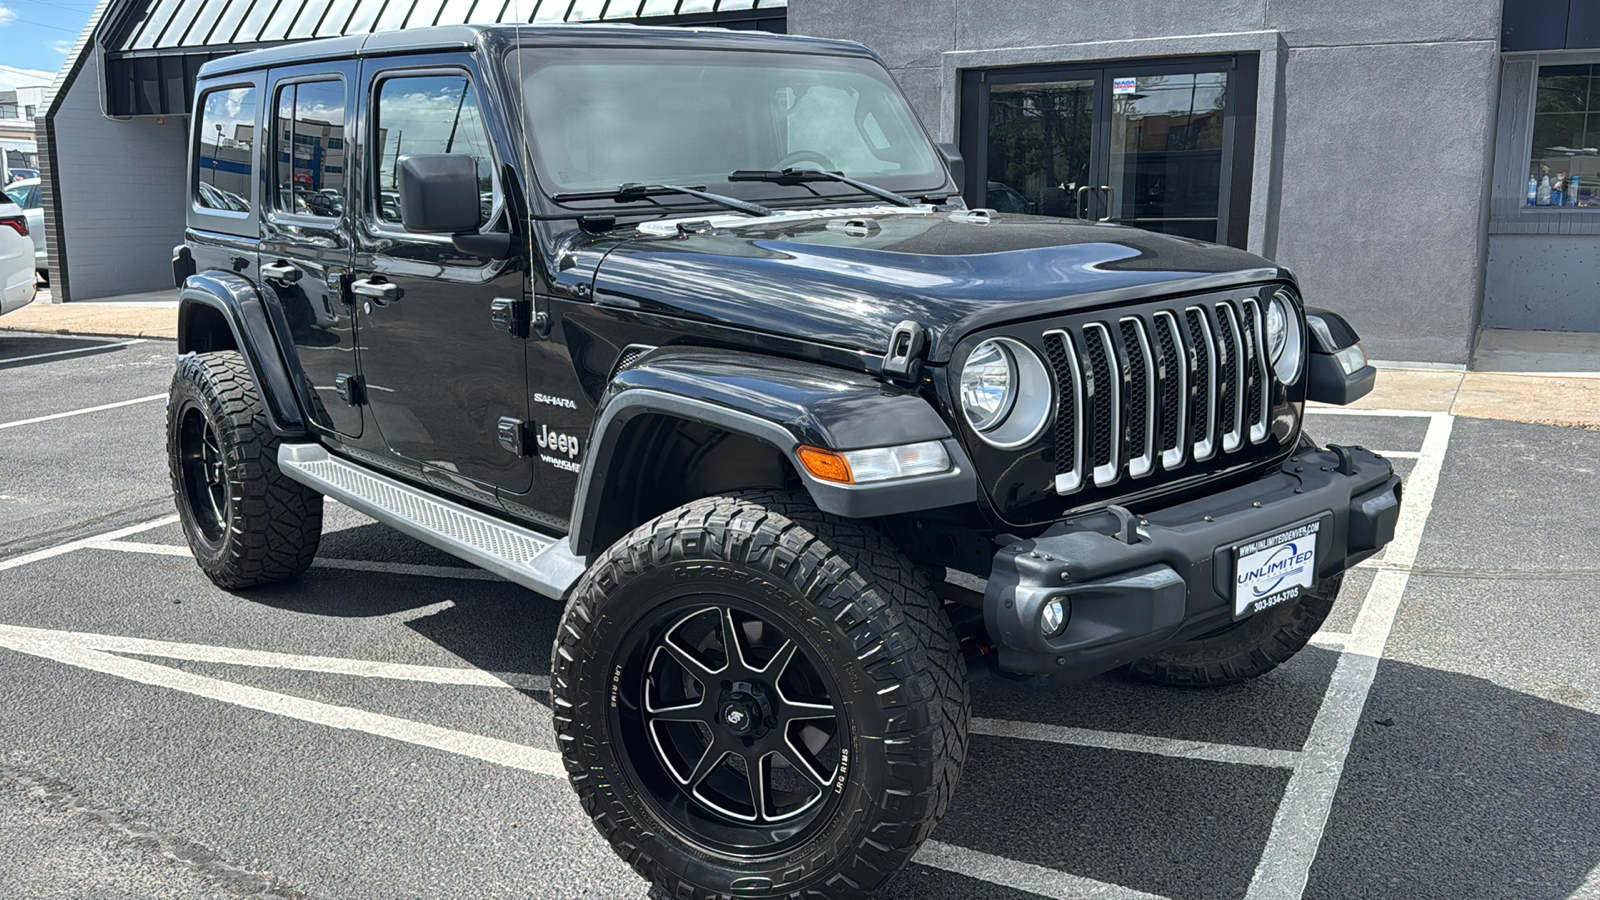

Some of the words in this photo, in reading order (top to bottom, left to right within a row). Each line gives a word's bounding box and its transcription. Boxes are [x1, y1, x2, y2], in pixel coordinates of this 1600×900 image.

[534, 393, 577, 409] SAHARA
[536, 424, 579, 459] Jeep
[1239, 521, 1320, 557] WWW.UNLIMITEDDENVER.COM
[1238, 550, 1313, 584] UNLIMITED
[1253, 587, 1299, 612] 303-934-3705
[613, 664, 622, 682] LRG
[610, 684, 618, 707] RIMS
[834, 775, 845, 794] LRG
[840, 748, 849, 773] RIMS
